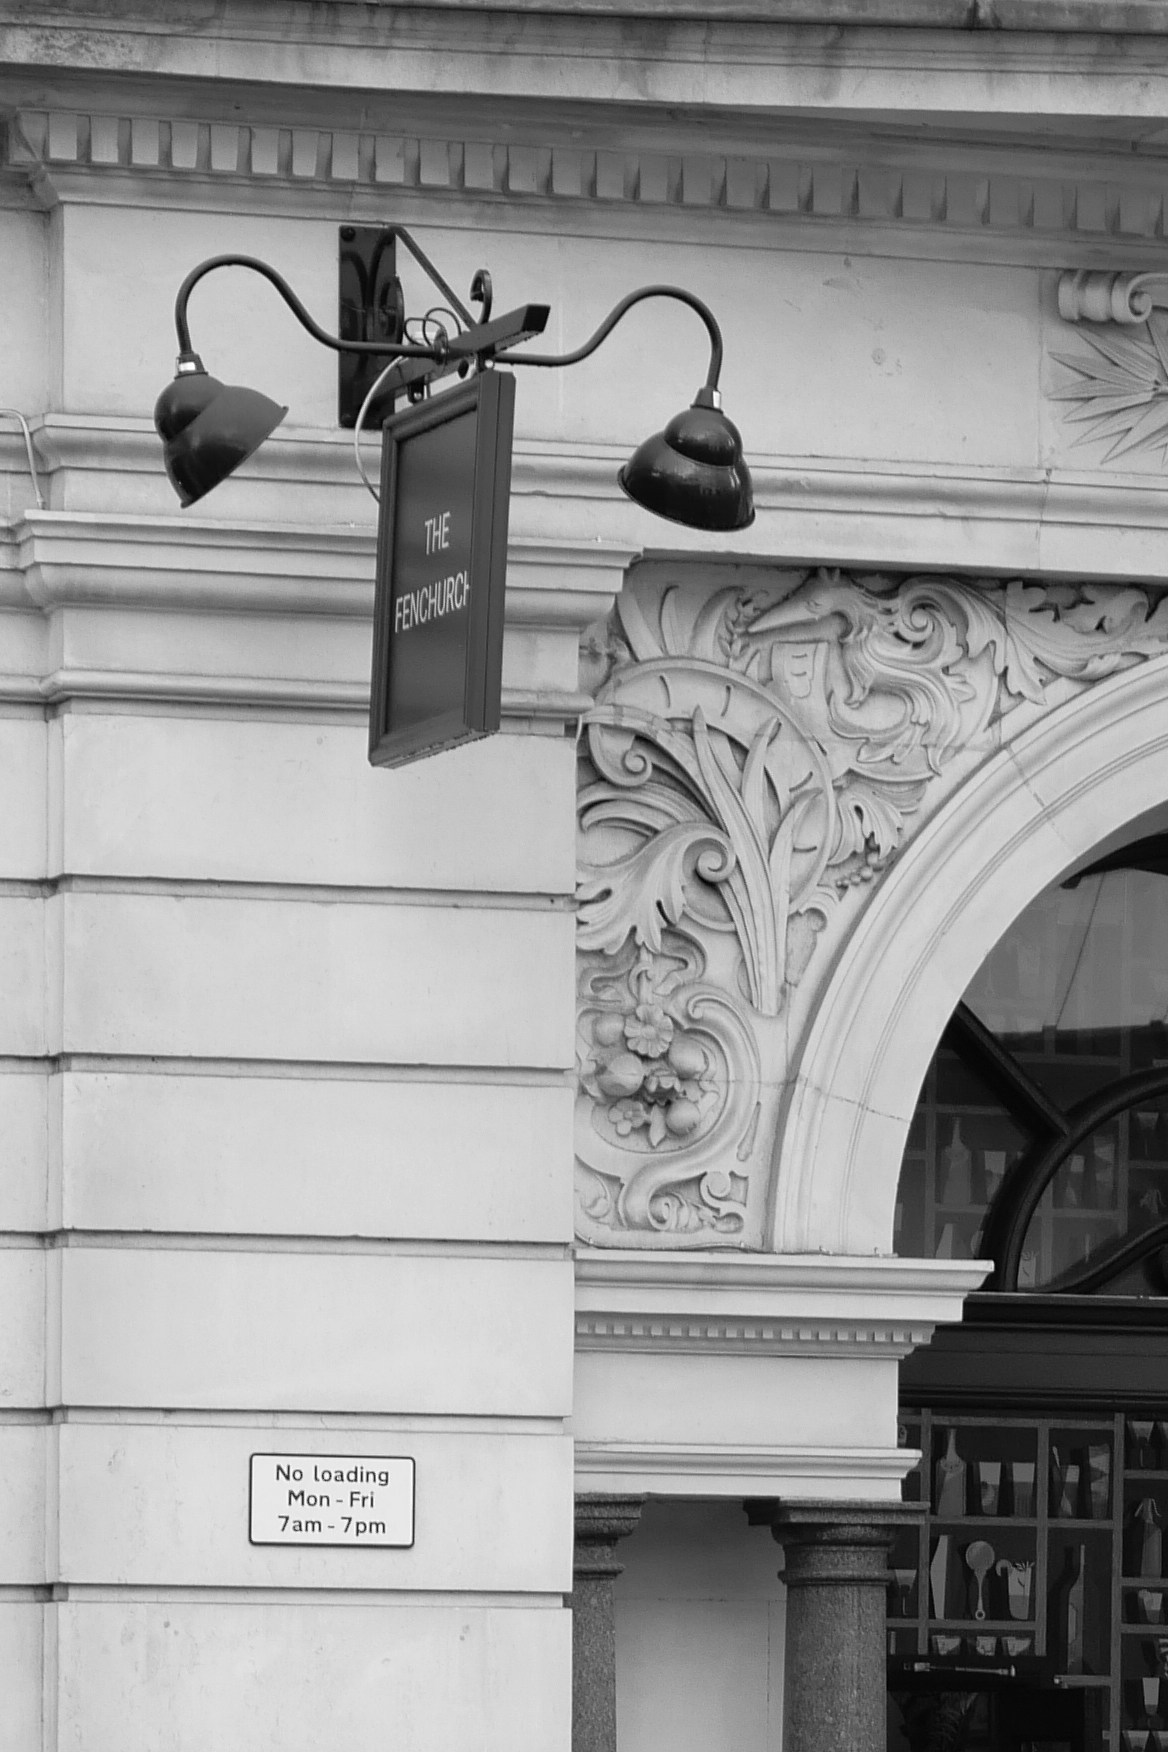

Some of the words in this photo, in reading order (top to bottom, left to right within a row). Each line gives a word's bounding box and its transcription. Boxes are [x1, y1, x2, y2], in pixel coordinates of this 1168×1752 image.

[425, 511, 451, 555] THE
[276, 1464, 304, 1482] No
[314, 1465, 389, 1487] loading
[288, 1489, 330, 1507] Mon
[350, 1491, 375, 1508] Fri
[278, 1515, 322, 1532] 7am
[341, 1516, 386, 1537] 7pm
